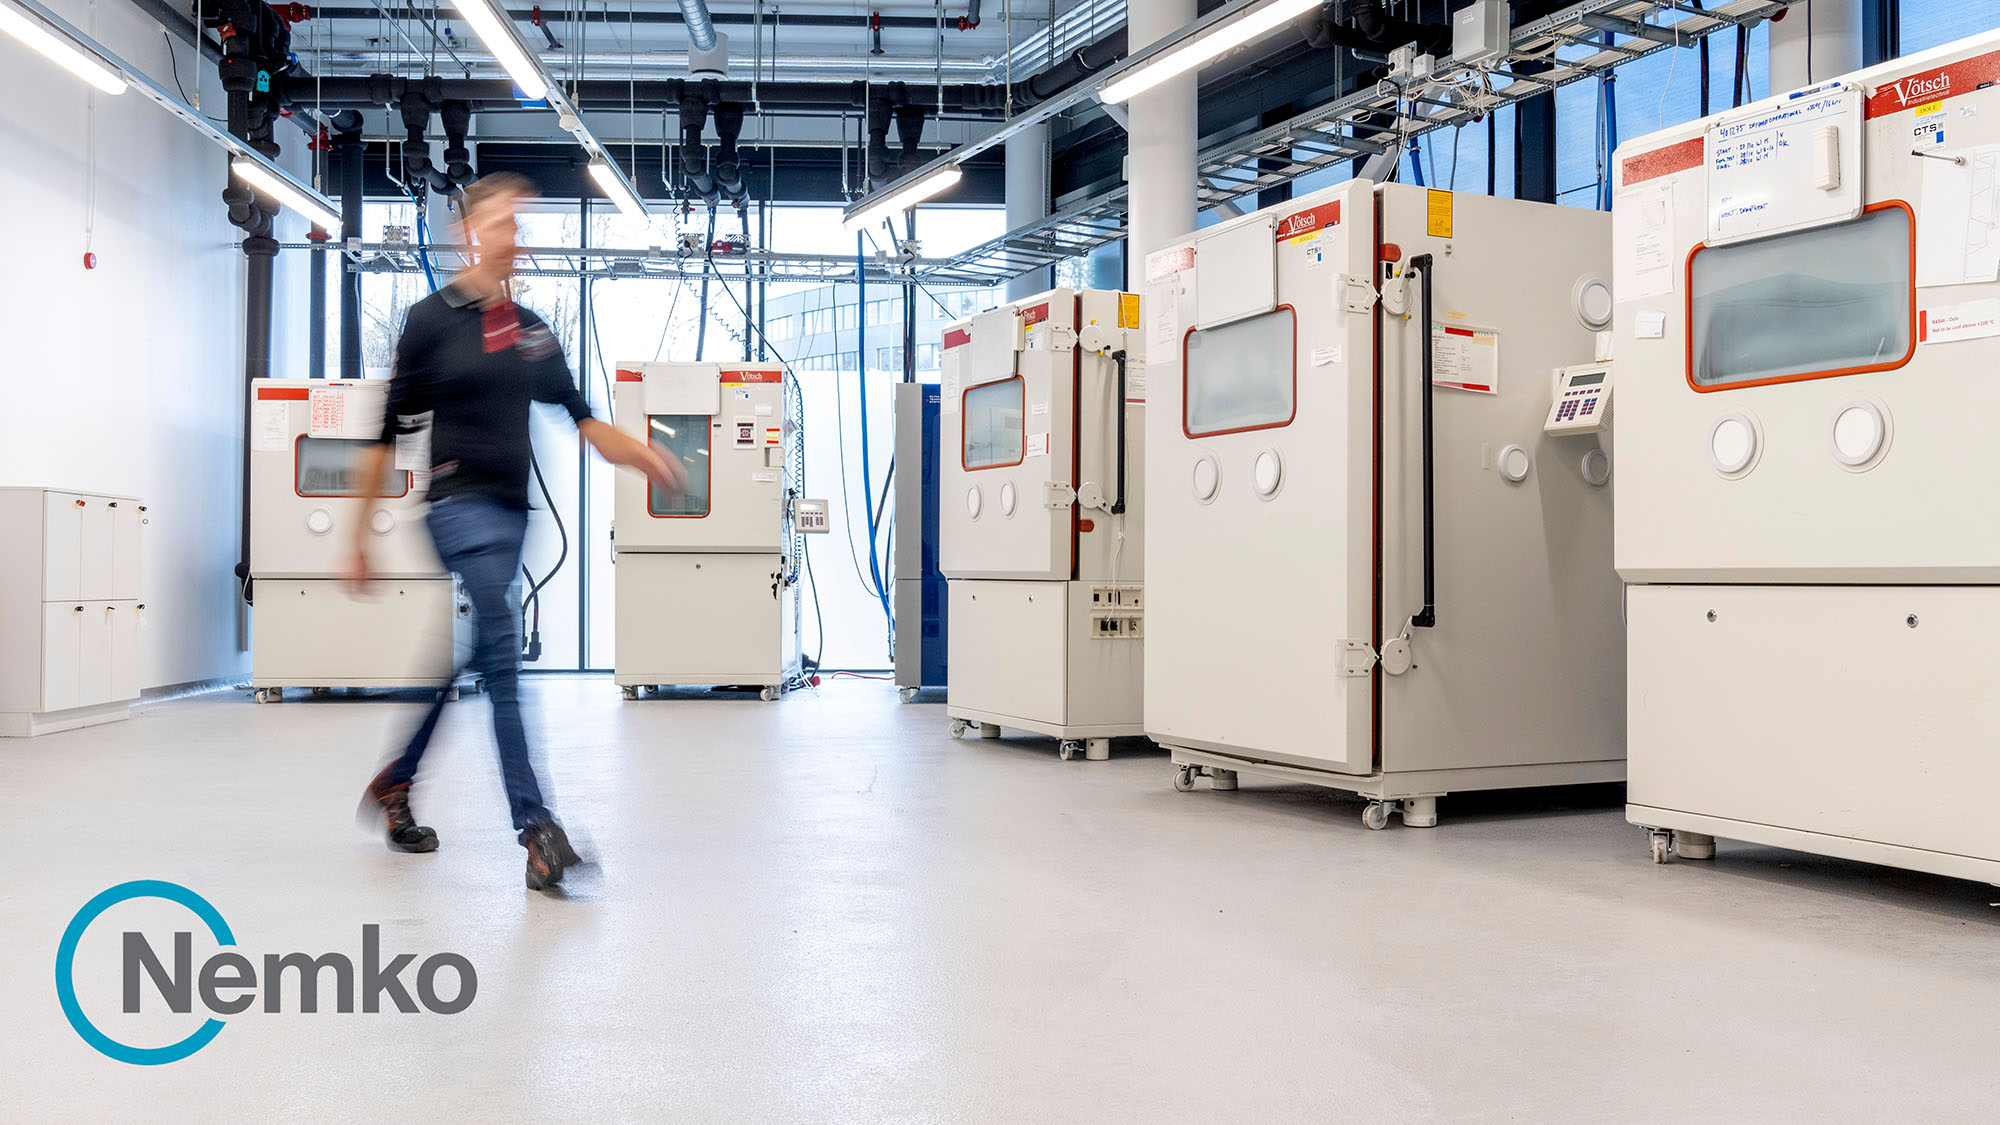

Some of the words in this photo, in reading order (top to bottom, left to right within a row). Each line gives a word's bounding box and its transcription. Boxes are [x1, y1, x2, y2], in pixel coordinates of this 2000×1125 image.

[1893, 72, 1950, 107] Vötsch
[1913, 124, 1937, 136] CTS
[1288, 212, 1316, 233] Vötsch
